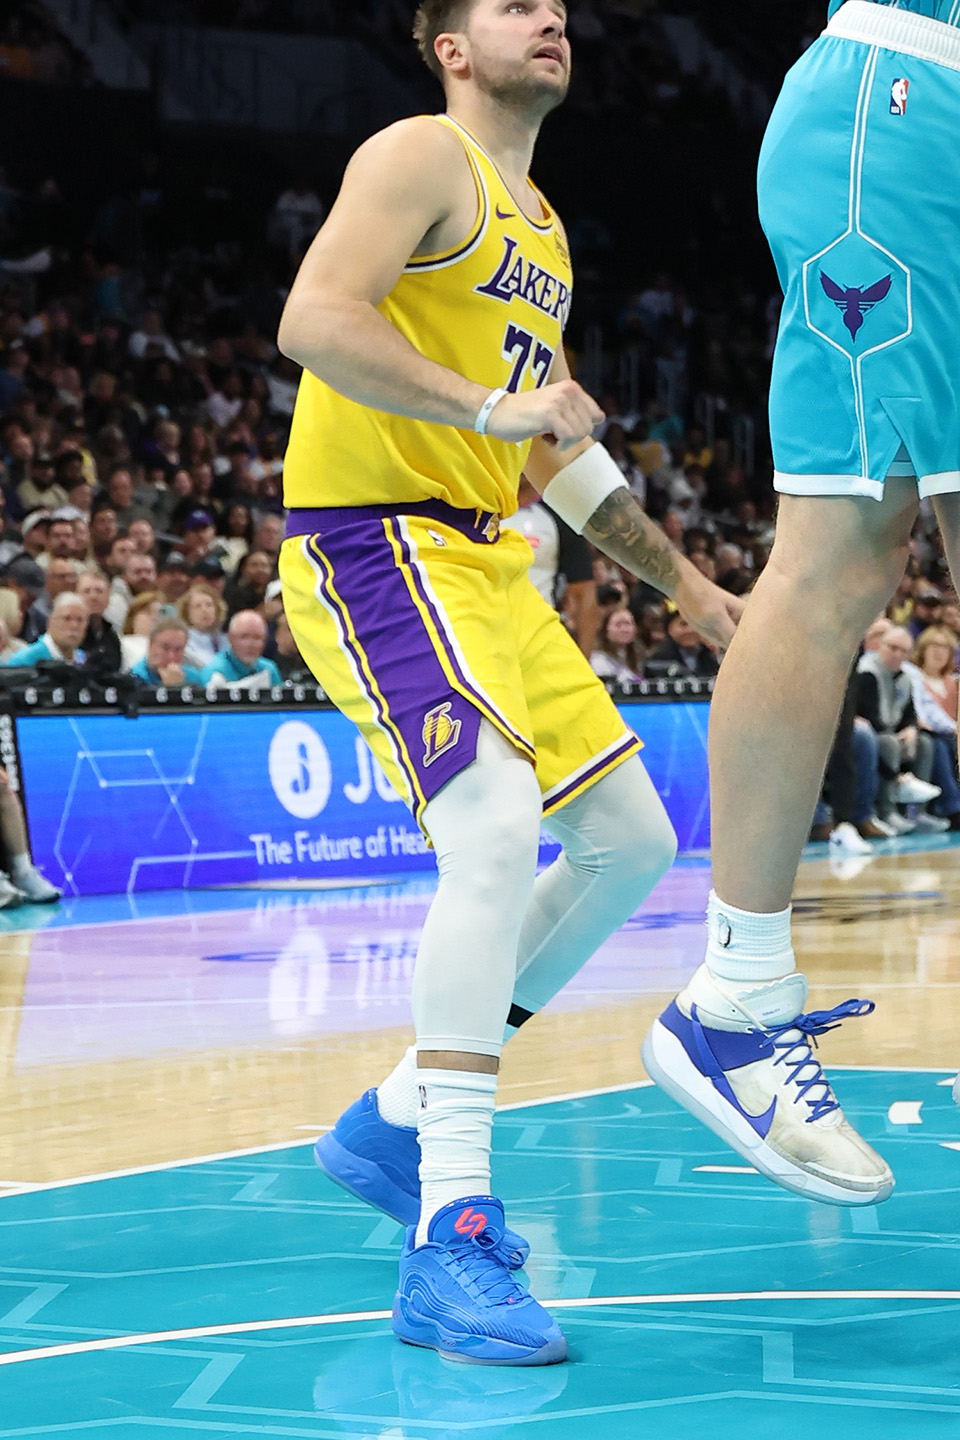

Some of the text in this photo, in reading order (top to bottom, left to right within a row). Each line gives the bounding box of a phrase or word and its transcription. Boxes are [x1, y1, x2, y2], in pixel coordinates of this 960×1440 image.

[500, 319, 556, 394] 77
[248, 832, 293, 866] The
[293, 830, 363, 863] Future
[364, 825, 387, 859] of
